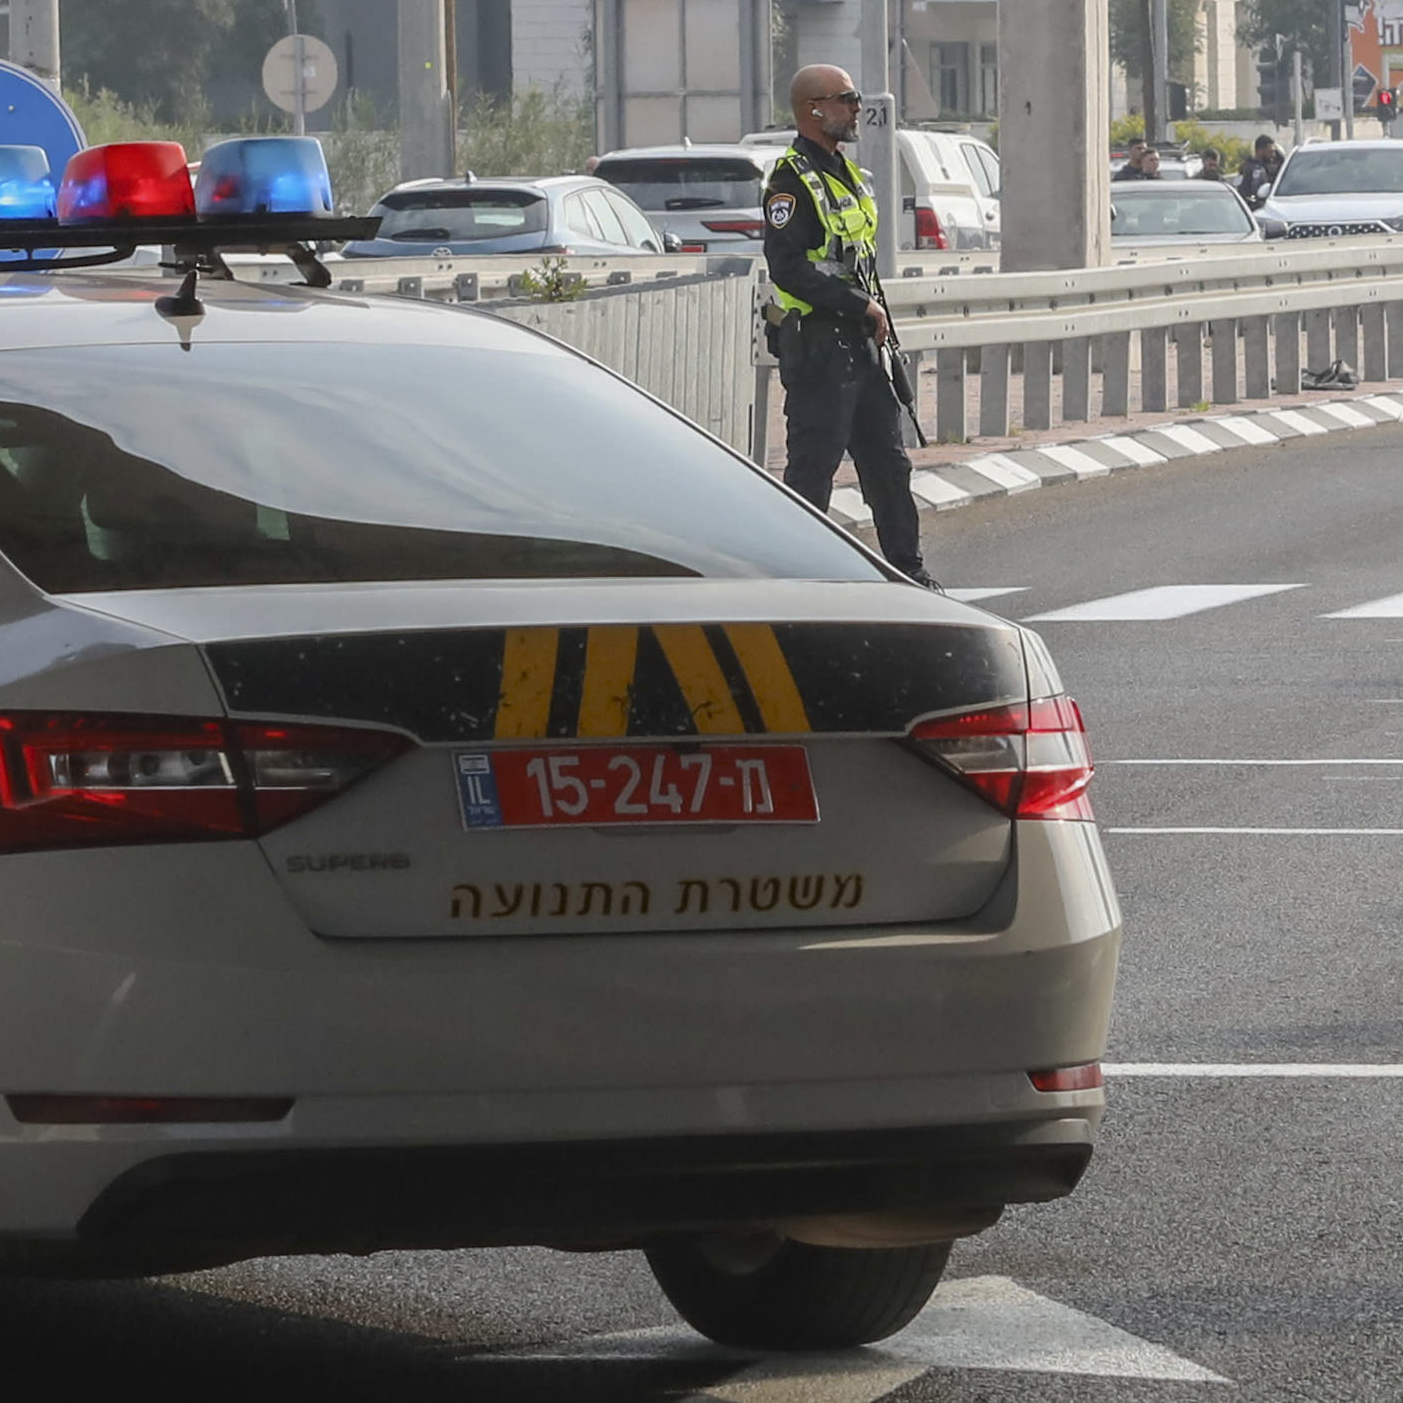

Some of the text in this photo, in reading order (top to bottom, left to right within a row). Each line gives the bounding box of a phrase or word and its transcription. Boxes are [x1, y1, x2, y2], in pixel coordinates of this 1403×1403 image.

[467, 776, 491, 805] IL
[285, 851, 411, 873] SUPERB
[450, 873, 865, 920] משטרת התנועה
